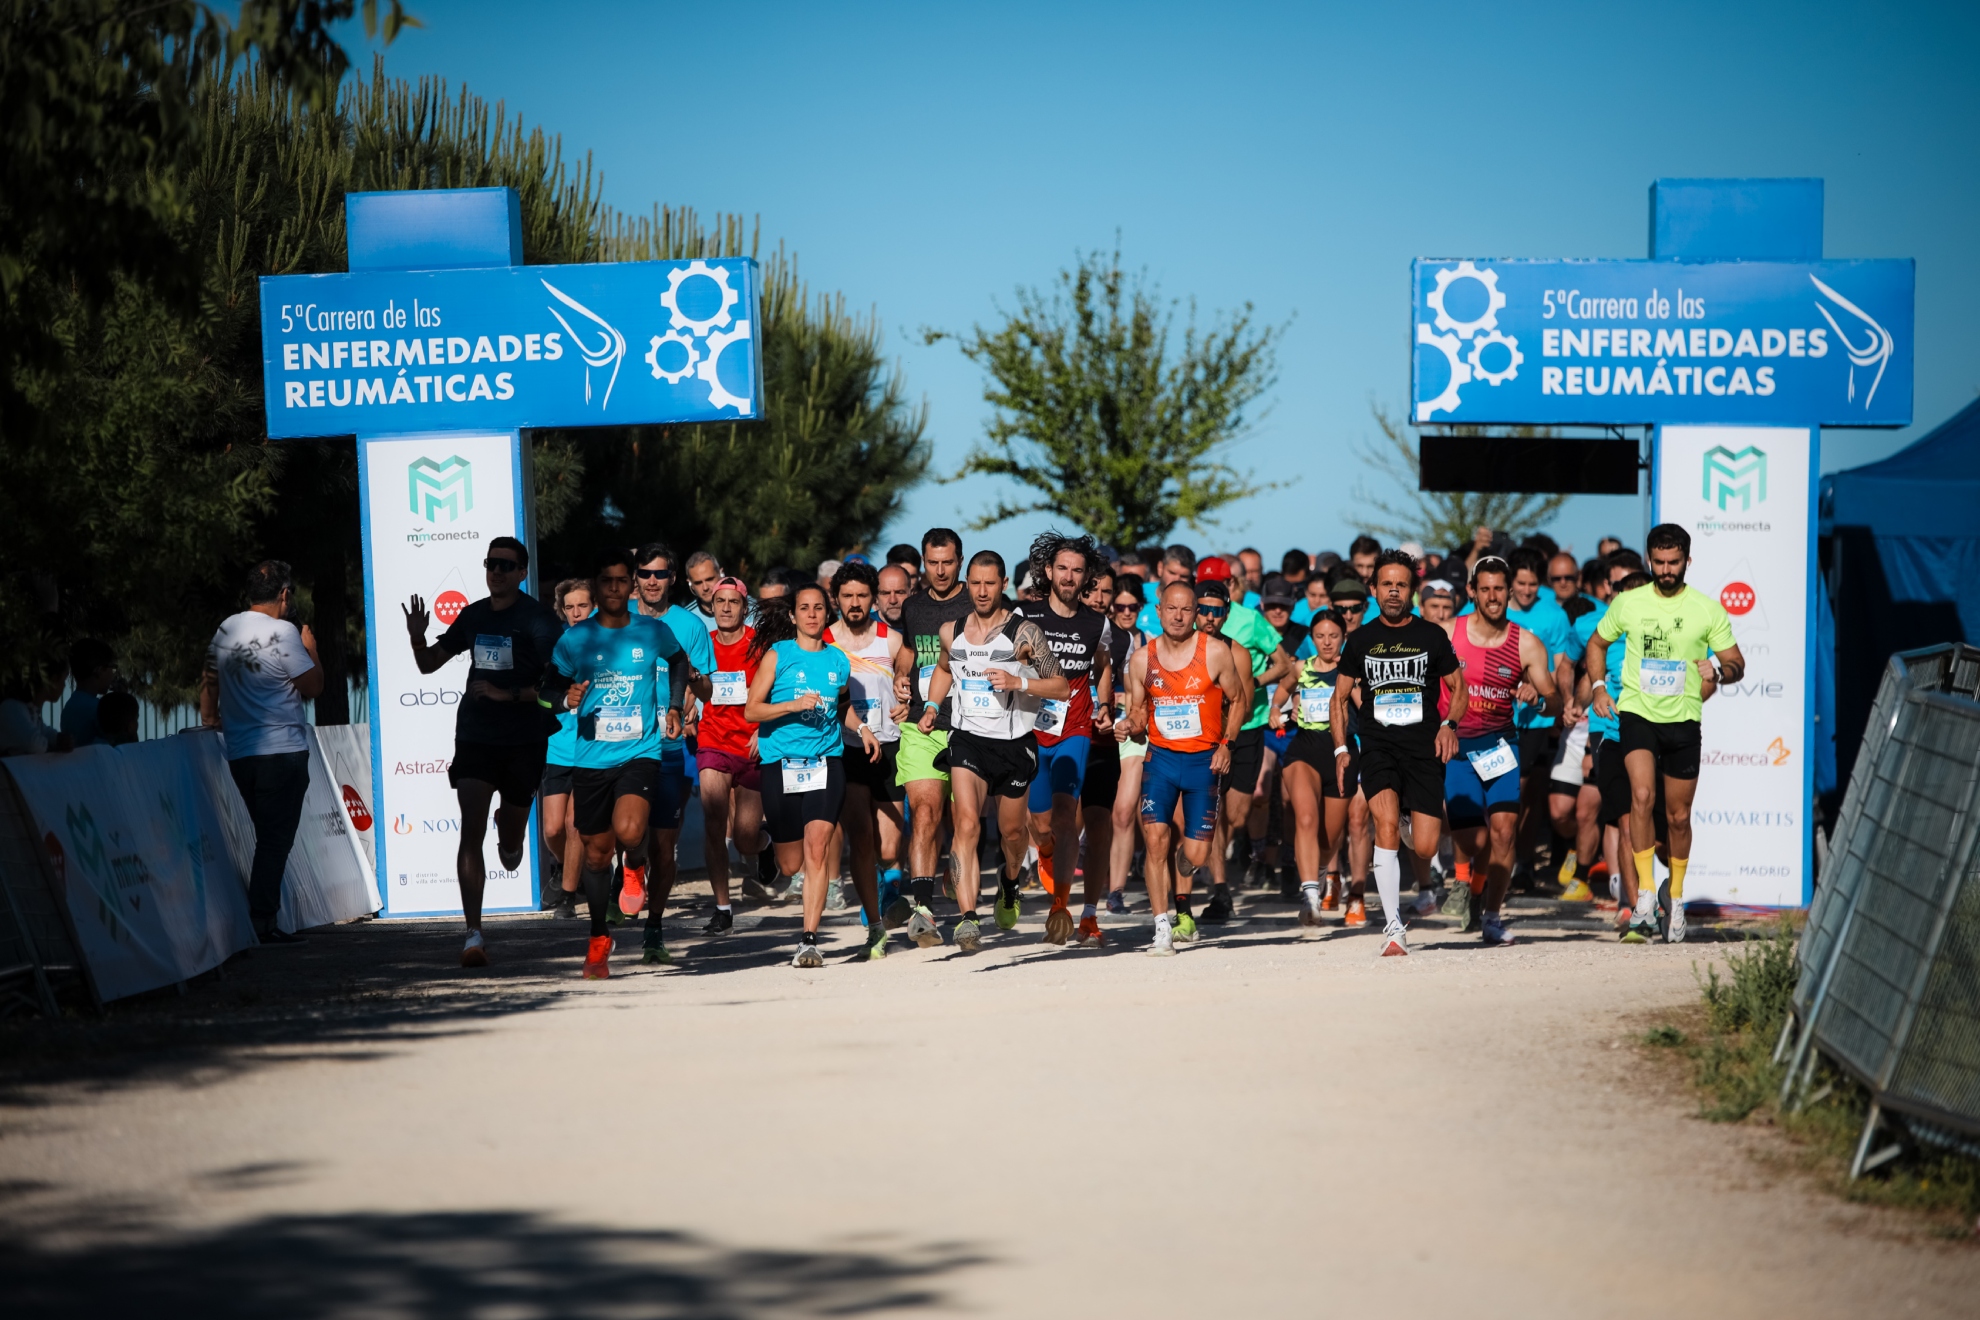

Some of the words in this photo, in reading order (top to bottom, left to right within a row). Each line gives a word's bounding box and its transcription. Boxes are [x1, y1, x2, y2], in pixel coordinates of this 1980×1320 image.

[1645, 288, 1671, 320] de
[1677, 287, 1705, 320] las
[383, 299, 407, 329] de
[413, 298, 441, 328] las
[1542, 328, 1829, 359] ENFERMEDADES
[283, 332, 563, 371] ENFERMEDADES
[1541, 357, 1777, 396] REUMÁTICAS
[284, 367, 515, 409] REUMÁTICAS
[1697, 521, 1771, 532] mmconecta
[407, 530, 480, 542] mmconecta
[1369, 643, 1387, 655] The
[1389, 642, 1421, 653] Insane
[485, 650, 499, 662] 78
[1364, 655, 1428, 686] CHARLIE
[1650, 675, 1676, 686] 659
[720, 686, 734, 697] 29
[973, 696, 990, 707] 98
[1308, 702, 1329, 713] 642
[1386, 708, 1411, 718] 689
[605, 722, 632, 733] 646
[1166, 719, 1191, 731] 582
[1482, 754, 1505, 772] 560
[797, 772, 811, 783] 81
[1694, 809, 1794, 828] NOVARTIS
[1740, 865, 1791, 878] MADRID
